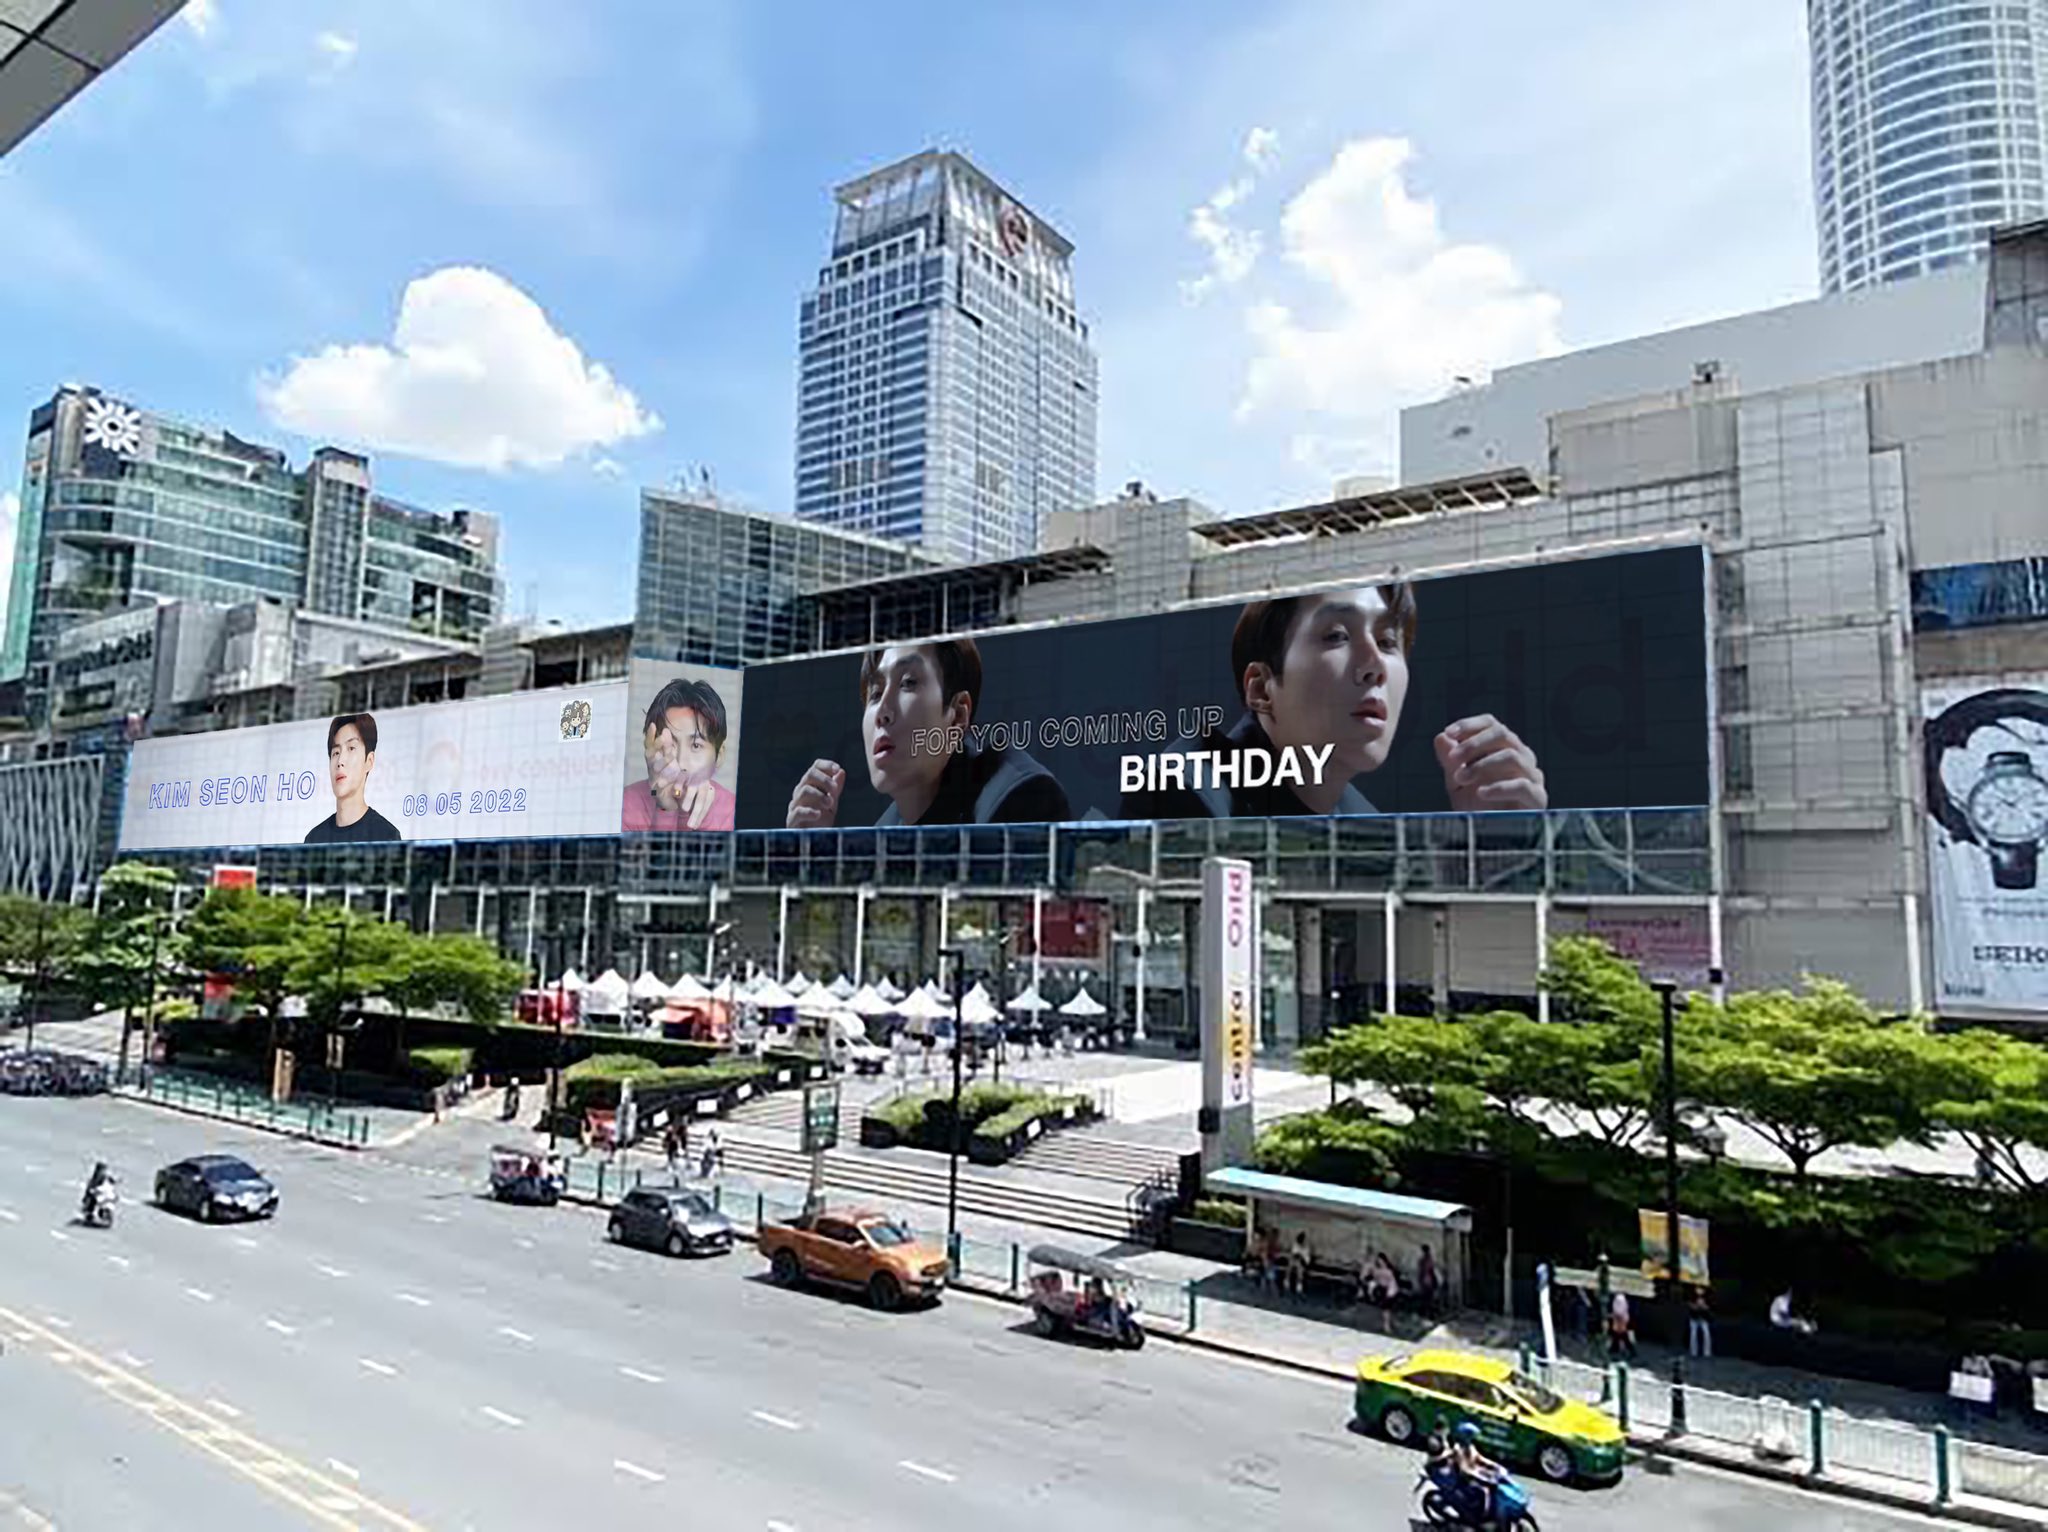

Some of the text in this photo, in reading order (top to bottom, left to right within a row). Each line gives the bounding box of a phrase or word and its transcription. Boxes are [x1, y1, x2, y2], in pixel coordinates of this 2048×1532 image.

[911, 705, 1224, 757] FOR YOU COMING UP
[1119, 743, 1336, 793] BIRTHDAY
[149, 770, 316, 809] KIM SEON HO
[402, 788, 527, 817] 08 05 2022
[1973, 945, 2048, 963] SEIK
